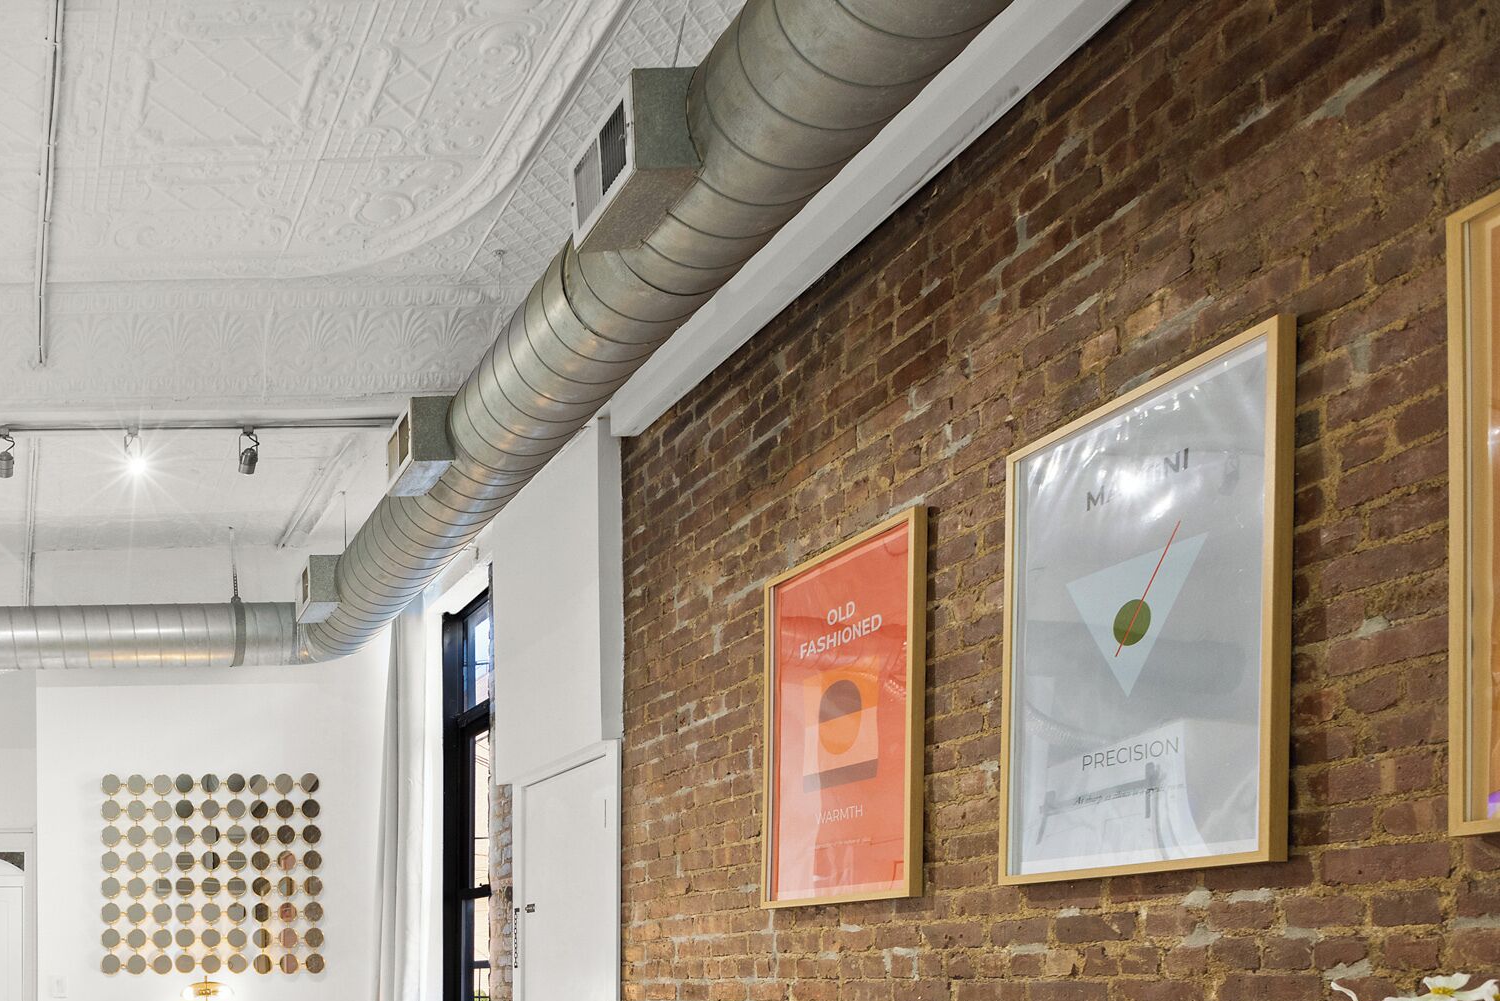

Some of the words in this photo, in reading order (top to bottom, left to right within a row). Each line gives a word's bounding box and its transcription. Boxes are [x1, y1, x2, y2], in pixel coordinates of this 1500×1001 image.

[827, 601, 855, 625] OLD
[800, 614, 882, 659] FASHIONED
[1082, 736, 1179, 771] PRECISION
[815, 805, 863, 825] WARMTH
